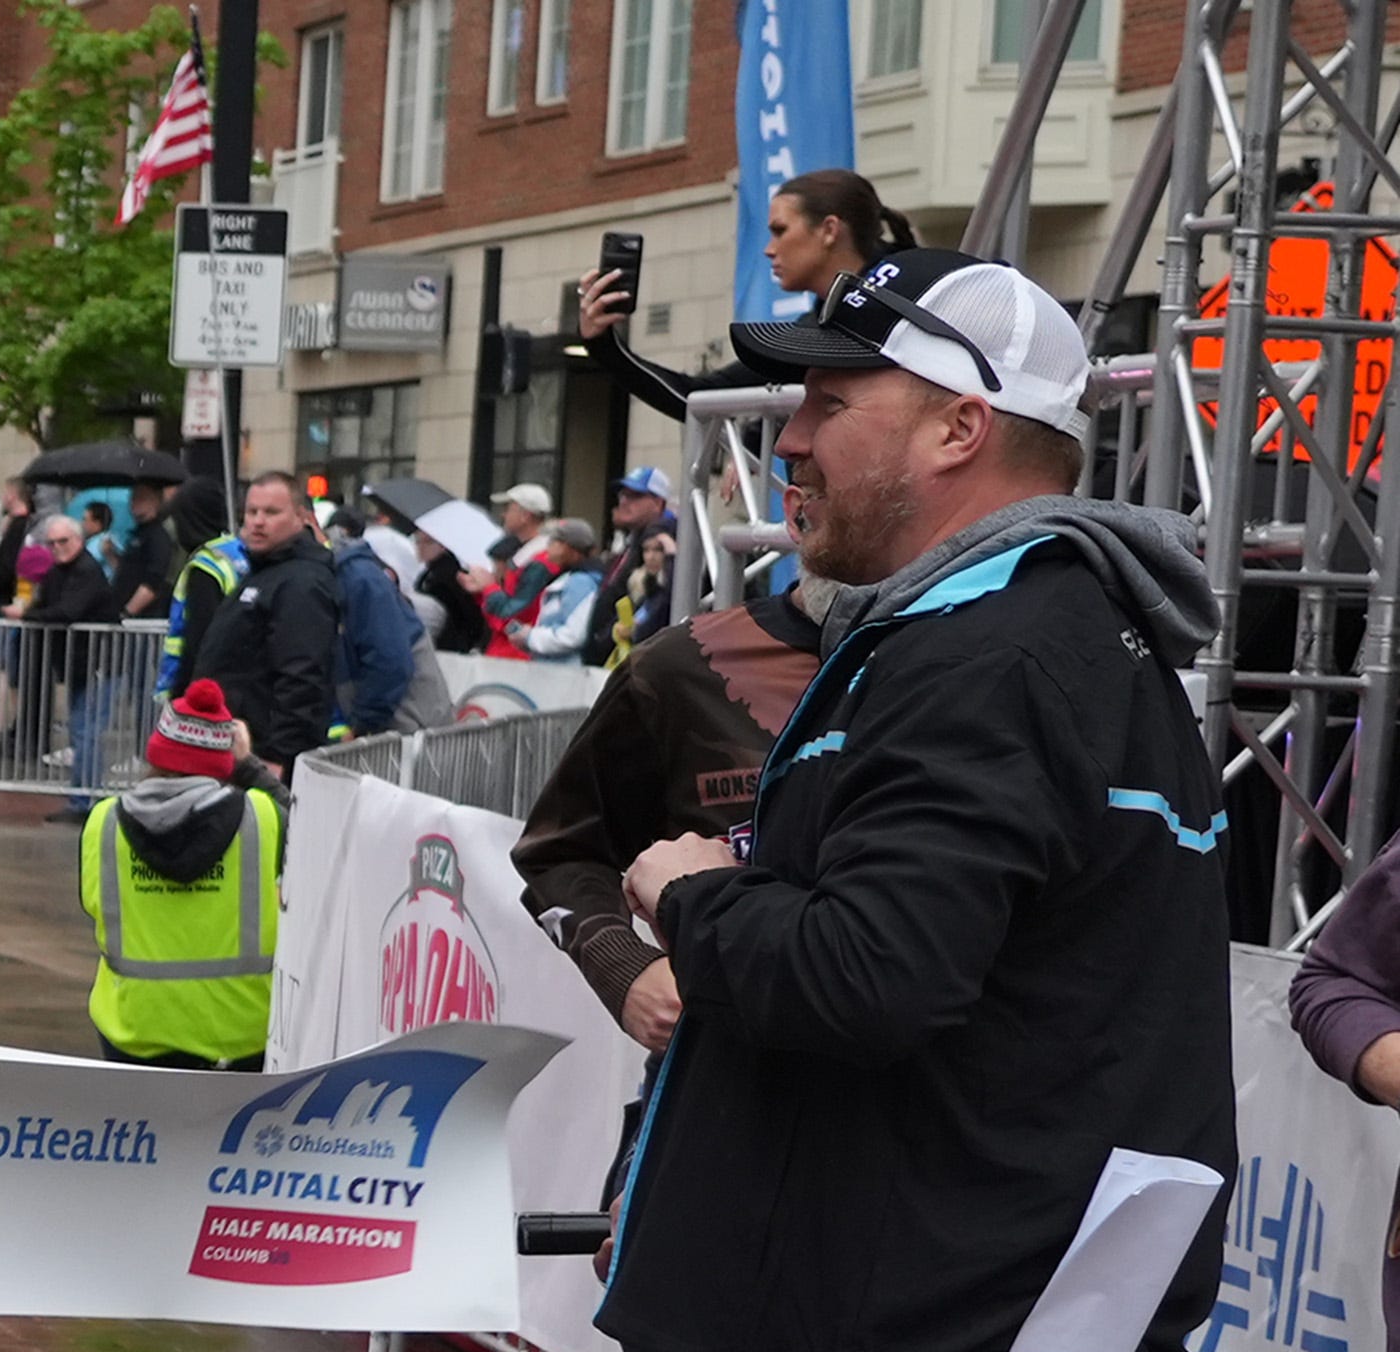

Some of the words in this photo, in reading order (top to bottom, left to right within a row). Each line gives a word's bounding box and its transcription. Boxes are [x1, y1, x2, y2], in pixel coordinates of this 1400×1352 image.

[211, 215, 257, 231] RIGHT
[212, 233, 253, 250] LANE
[235, 262, 264, 276] AND
[215, 281, 246, 295] TAXI
[705, 774, 757, 799] MONS
[288, 1134, 394, 1158] OhioHealth
[208, 1166, 342, 1202] CAPITAL
[347, 1176, 424, 1207] CITY
[208, 1217, 264, 1238] HALF
[266, 1221, 403, 1249] MARATHON
